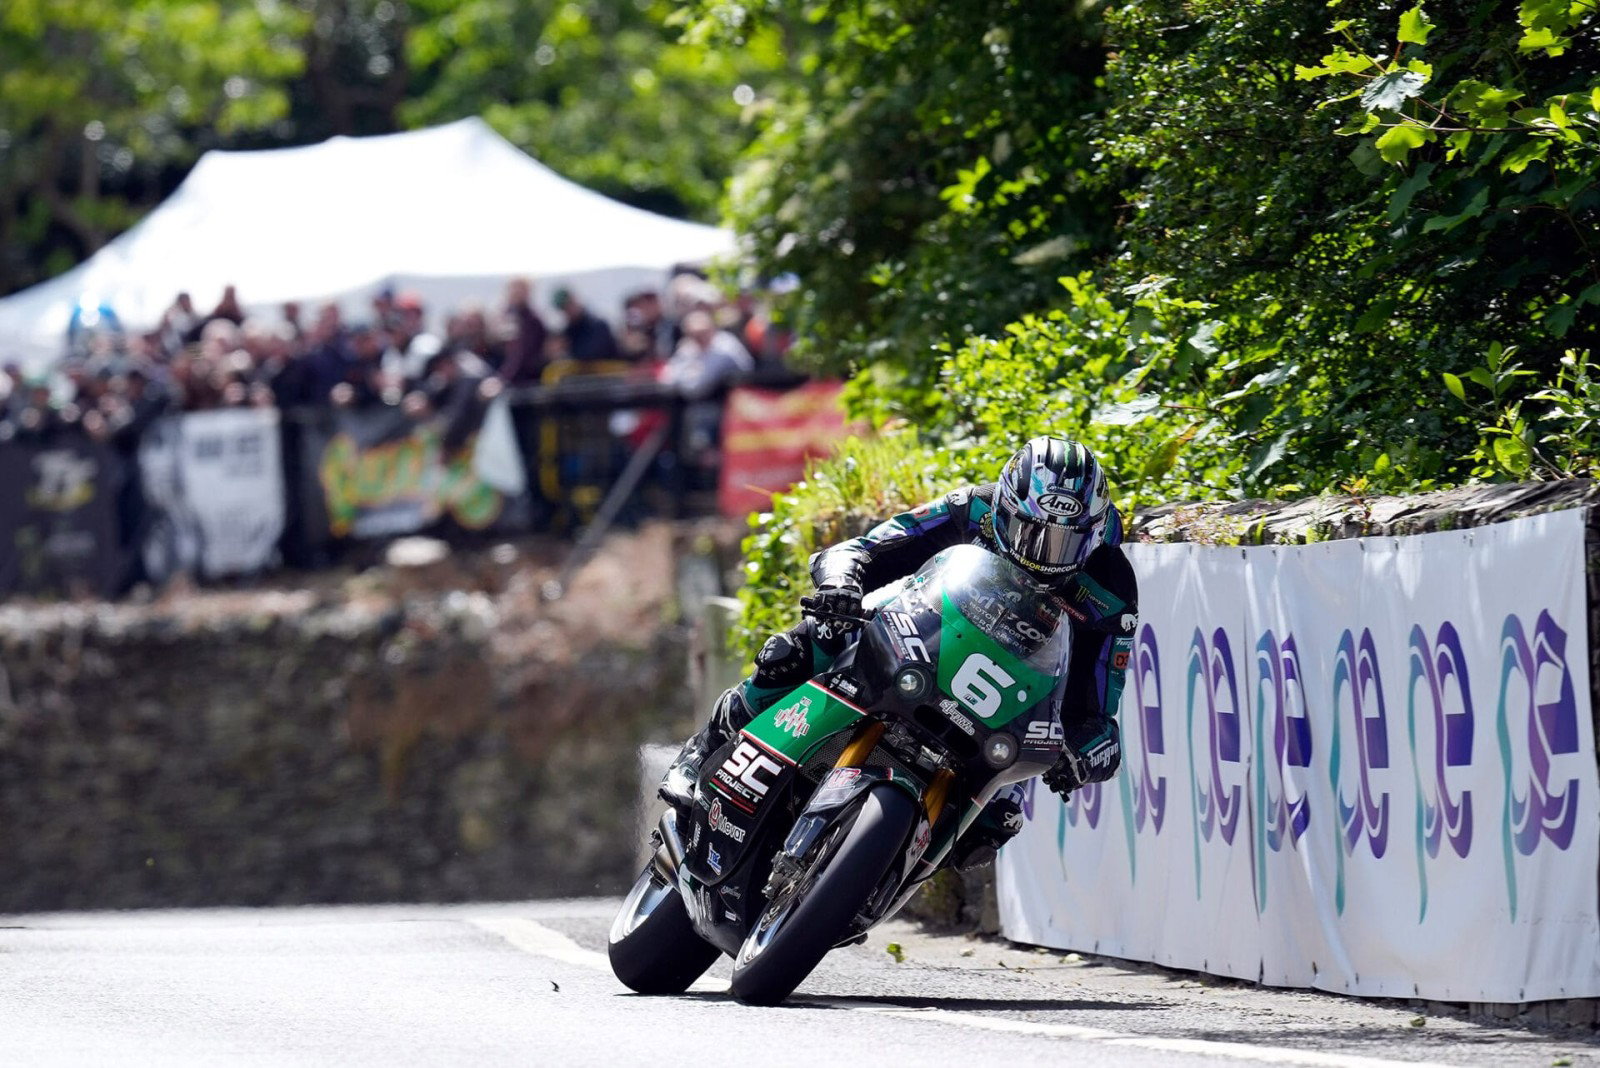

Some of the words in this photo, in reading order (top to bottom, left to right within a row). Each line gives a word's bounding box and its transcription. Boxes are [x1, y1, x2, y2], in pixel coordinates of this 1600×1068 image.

[1032, 517, 1079, 530] PARAMOUNT
[1040, 495, 1077, 512] Arai
[883, 611, 912, 661] PROJECT
[890, 611, 932, 663] SC
[951, 653, 1016, 718] 6
[715, 769, 763, 803] PROJECT
[722, 741, 782, 796] SC
